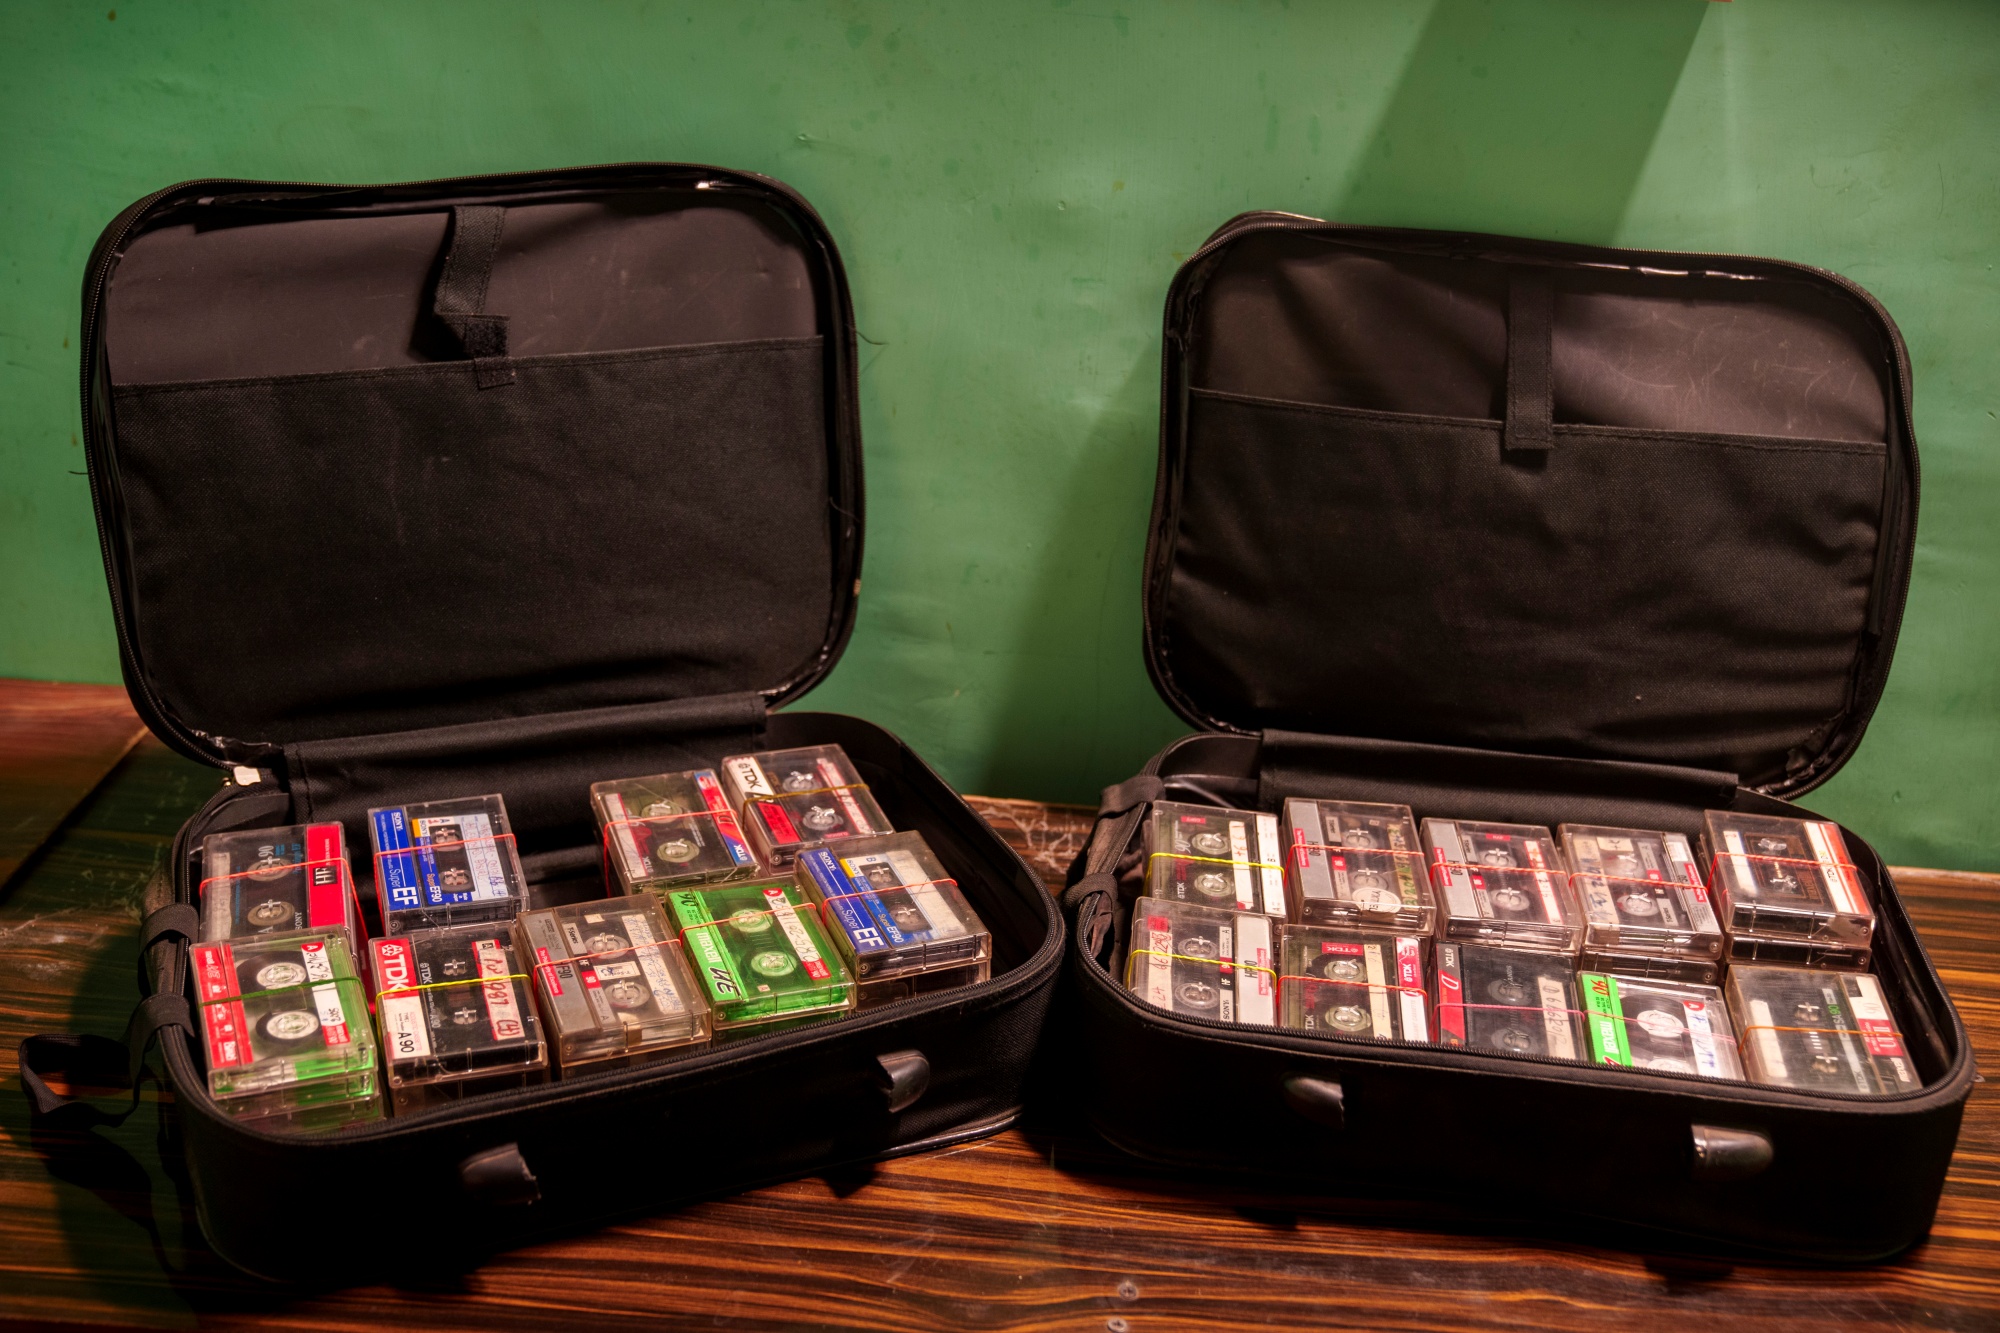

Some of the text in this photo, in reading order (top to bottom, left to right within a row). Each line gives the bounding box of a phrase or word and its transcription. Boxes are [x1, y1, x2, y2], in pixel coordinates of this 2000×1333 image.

[741, 767, 762, 789] TDK
[392, 812, 403, 830] SONY
[420, 820, 429, 836] SONY
[258, 845, 274, 857] 90
[734, 844, 745, 857] TDK
[1175, 840, 1191, 853] 90
[819, 851, 836, 871] SONY
[847, 859, 860, 876] SONY
[316, 868, 336, 885] HF
[388, 868, 419, 905] Super EF
[426, 873, 442, 902] Super EF90
[1177, 882, 1185, 894] TDK
[678, 893, 698, 906] 90
[1664, 908, 1674, 922] T-Series
[258, 926, 273, 934] A
[567, 927, 579, 944] T-Series
[842, 909, 885, 947] Super EF
[878, 913, 904, 943] Super EF90
[696, 932, 722, 963] maxell
[578, 959, 590, 969] HF
[1446, 953, 1454, 968] TDK
[383, 954, 410, 991] TDK
[421, 968, 433, 984] TDK
[815, 962, 829, 976] maxell
[1245, 960, 1258, 978] HF0
[1403, 964, 1412, 978] TDK
[549, 976, 560, 994] Excellence
[585, 976, 596, 984] 90
[1221, 977, 1231, 985] HF
[1441, 974, 1459, 990] D
[1591, 979, 1609, 996] 90
[1223, 1000, 1231, 1020] SONY
[1305, 1014, 1314, 1030] TDK
[1600, 1021, 1619, 1054] maxell
[400, 1040, 414, 1053] 90
[1855, 1071, 1865, 1082] TDK
[1891, 1058, 1910, 1082] maxell
